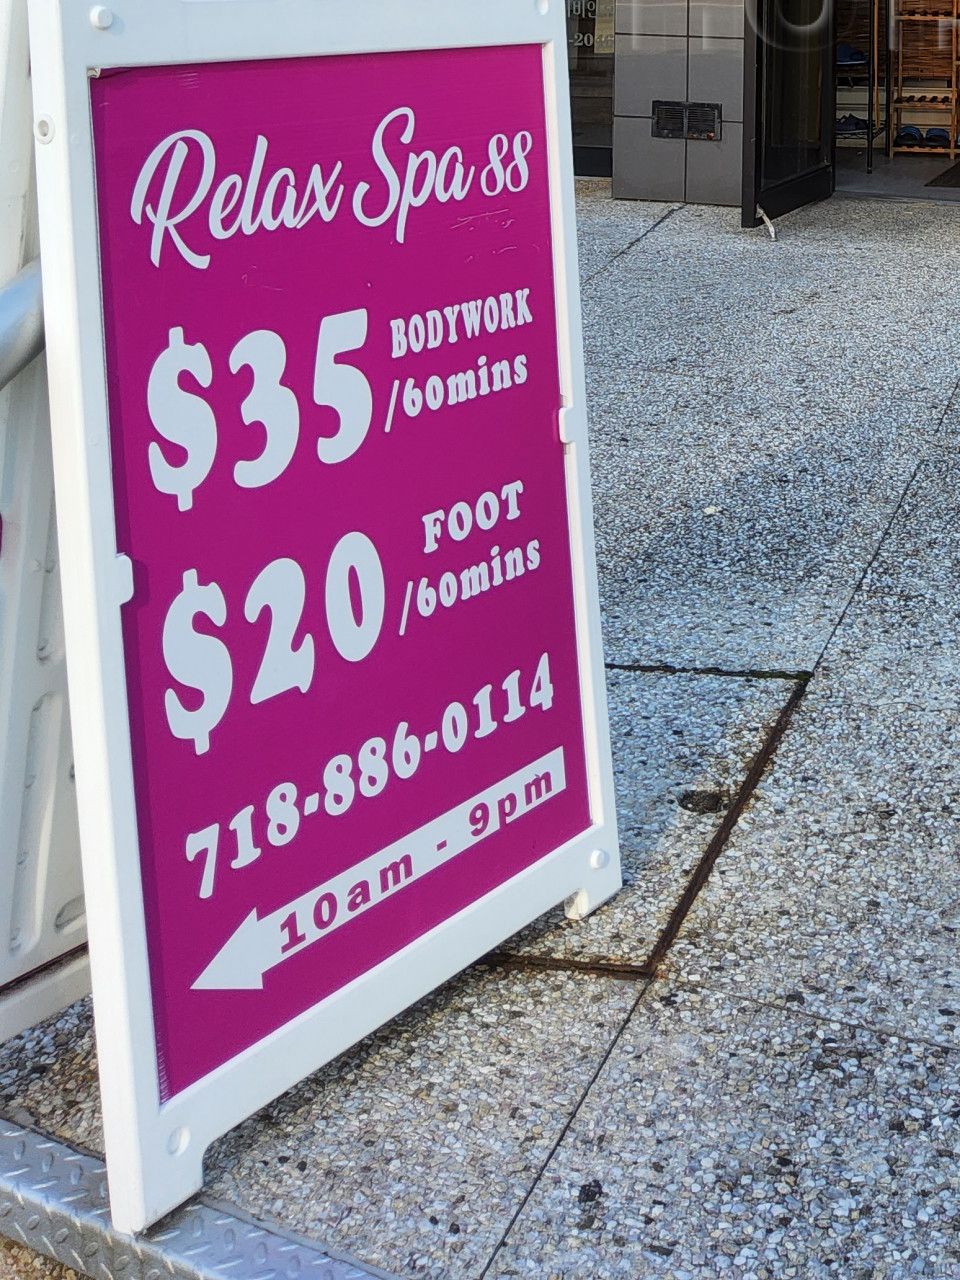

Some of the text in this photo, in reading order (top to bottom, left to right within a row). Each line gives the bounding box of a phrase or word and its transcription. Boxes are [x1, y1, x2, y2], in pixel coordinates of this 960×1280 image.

[131, 107, 533, 269] Relax Spa 88
[147, 287, 533, 512] $35 BODYWORK
[384, 353, 528, 433] /60mins
[422, 480, 524, 554] FOOT
[162, 531, 540, 756] $20 /60mins
[186, 652, 554, 899] 718-886-0114
[280, 852, 413, 954] 10am
[468, 770, 553, 838] 9pm
